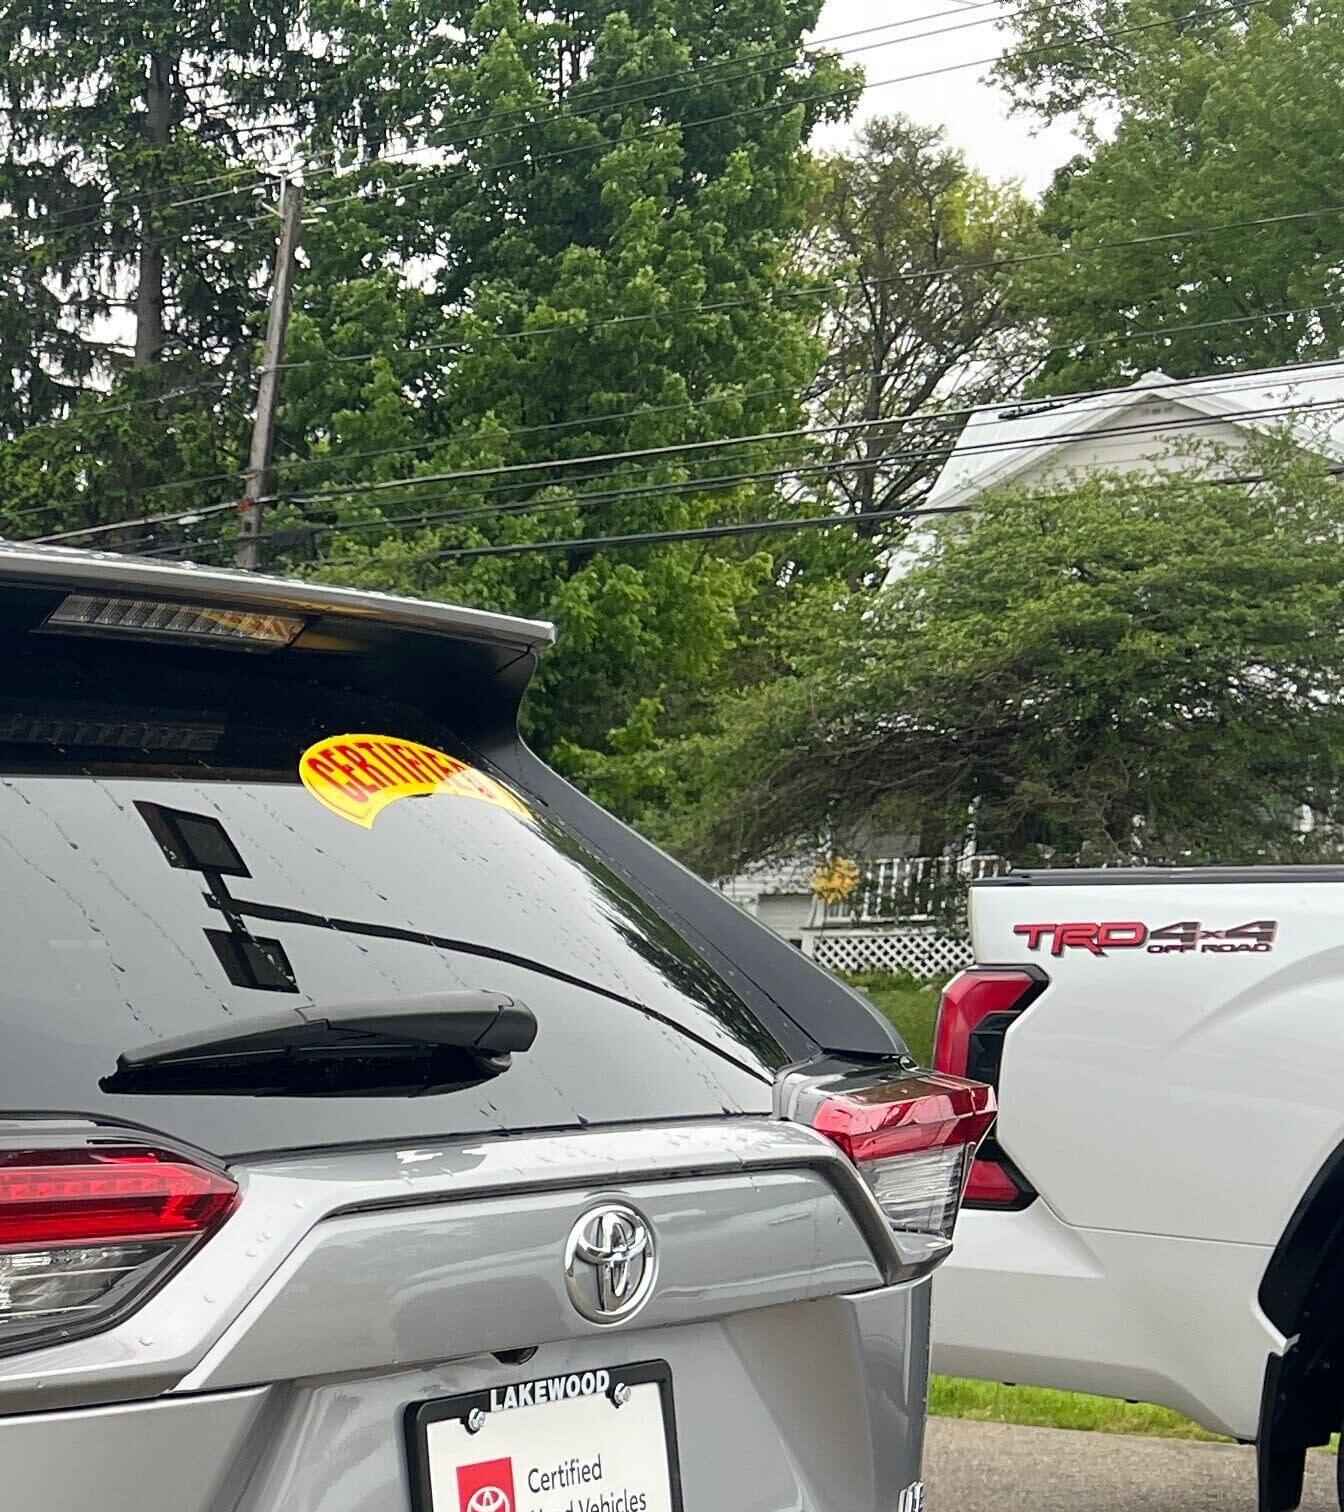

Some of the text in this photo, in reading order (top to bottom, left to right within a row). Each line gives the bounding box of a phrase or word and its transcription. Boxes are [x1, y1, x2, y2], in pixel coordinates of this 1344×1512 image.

[1013, 922, 1149, 958] TRD
[1146, 943, 1272, 954] OFF ROAD
[489, 1369, 610, 1413] LAKEWOOD
[527, 1453, 603, 1494] Certified
